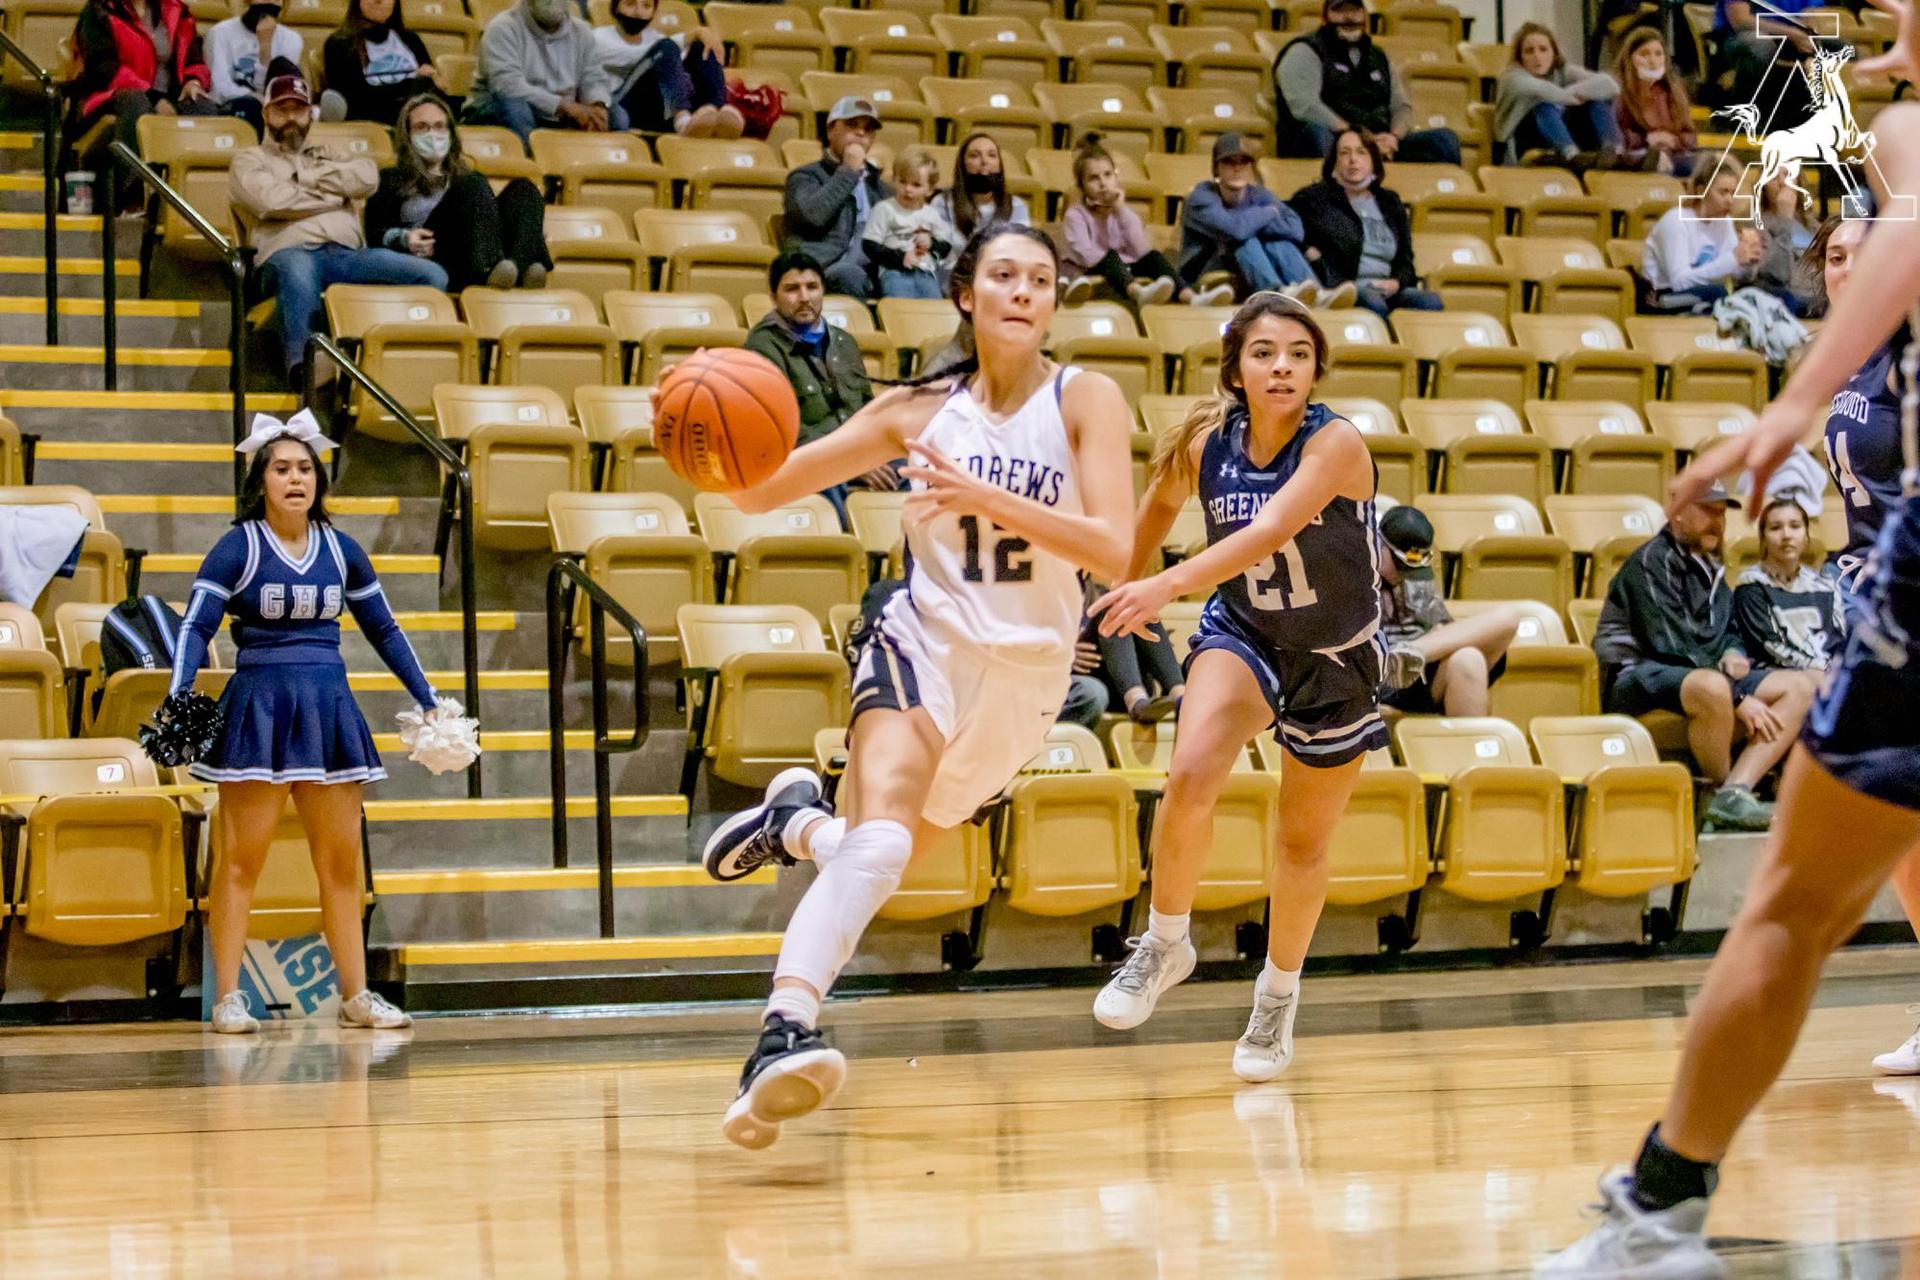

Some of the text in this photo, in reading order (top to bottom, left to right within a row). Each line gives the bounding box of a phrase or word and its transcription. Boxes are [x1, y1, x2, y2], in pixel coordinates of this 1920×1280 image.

[958, 514, 1033, 582] 12
[1244, 537, 1318, 611] 21
[260, 583, 343, 619] GHS
